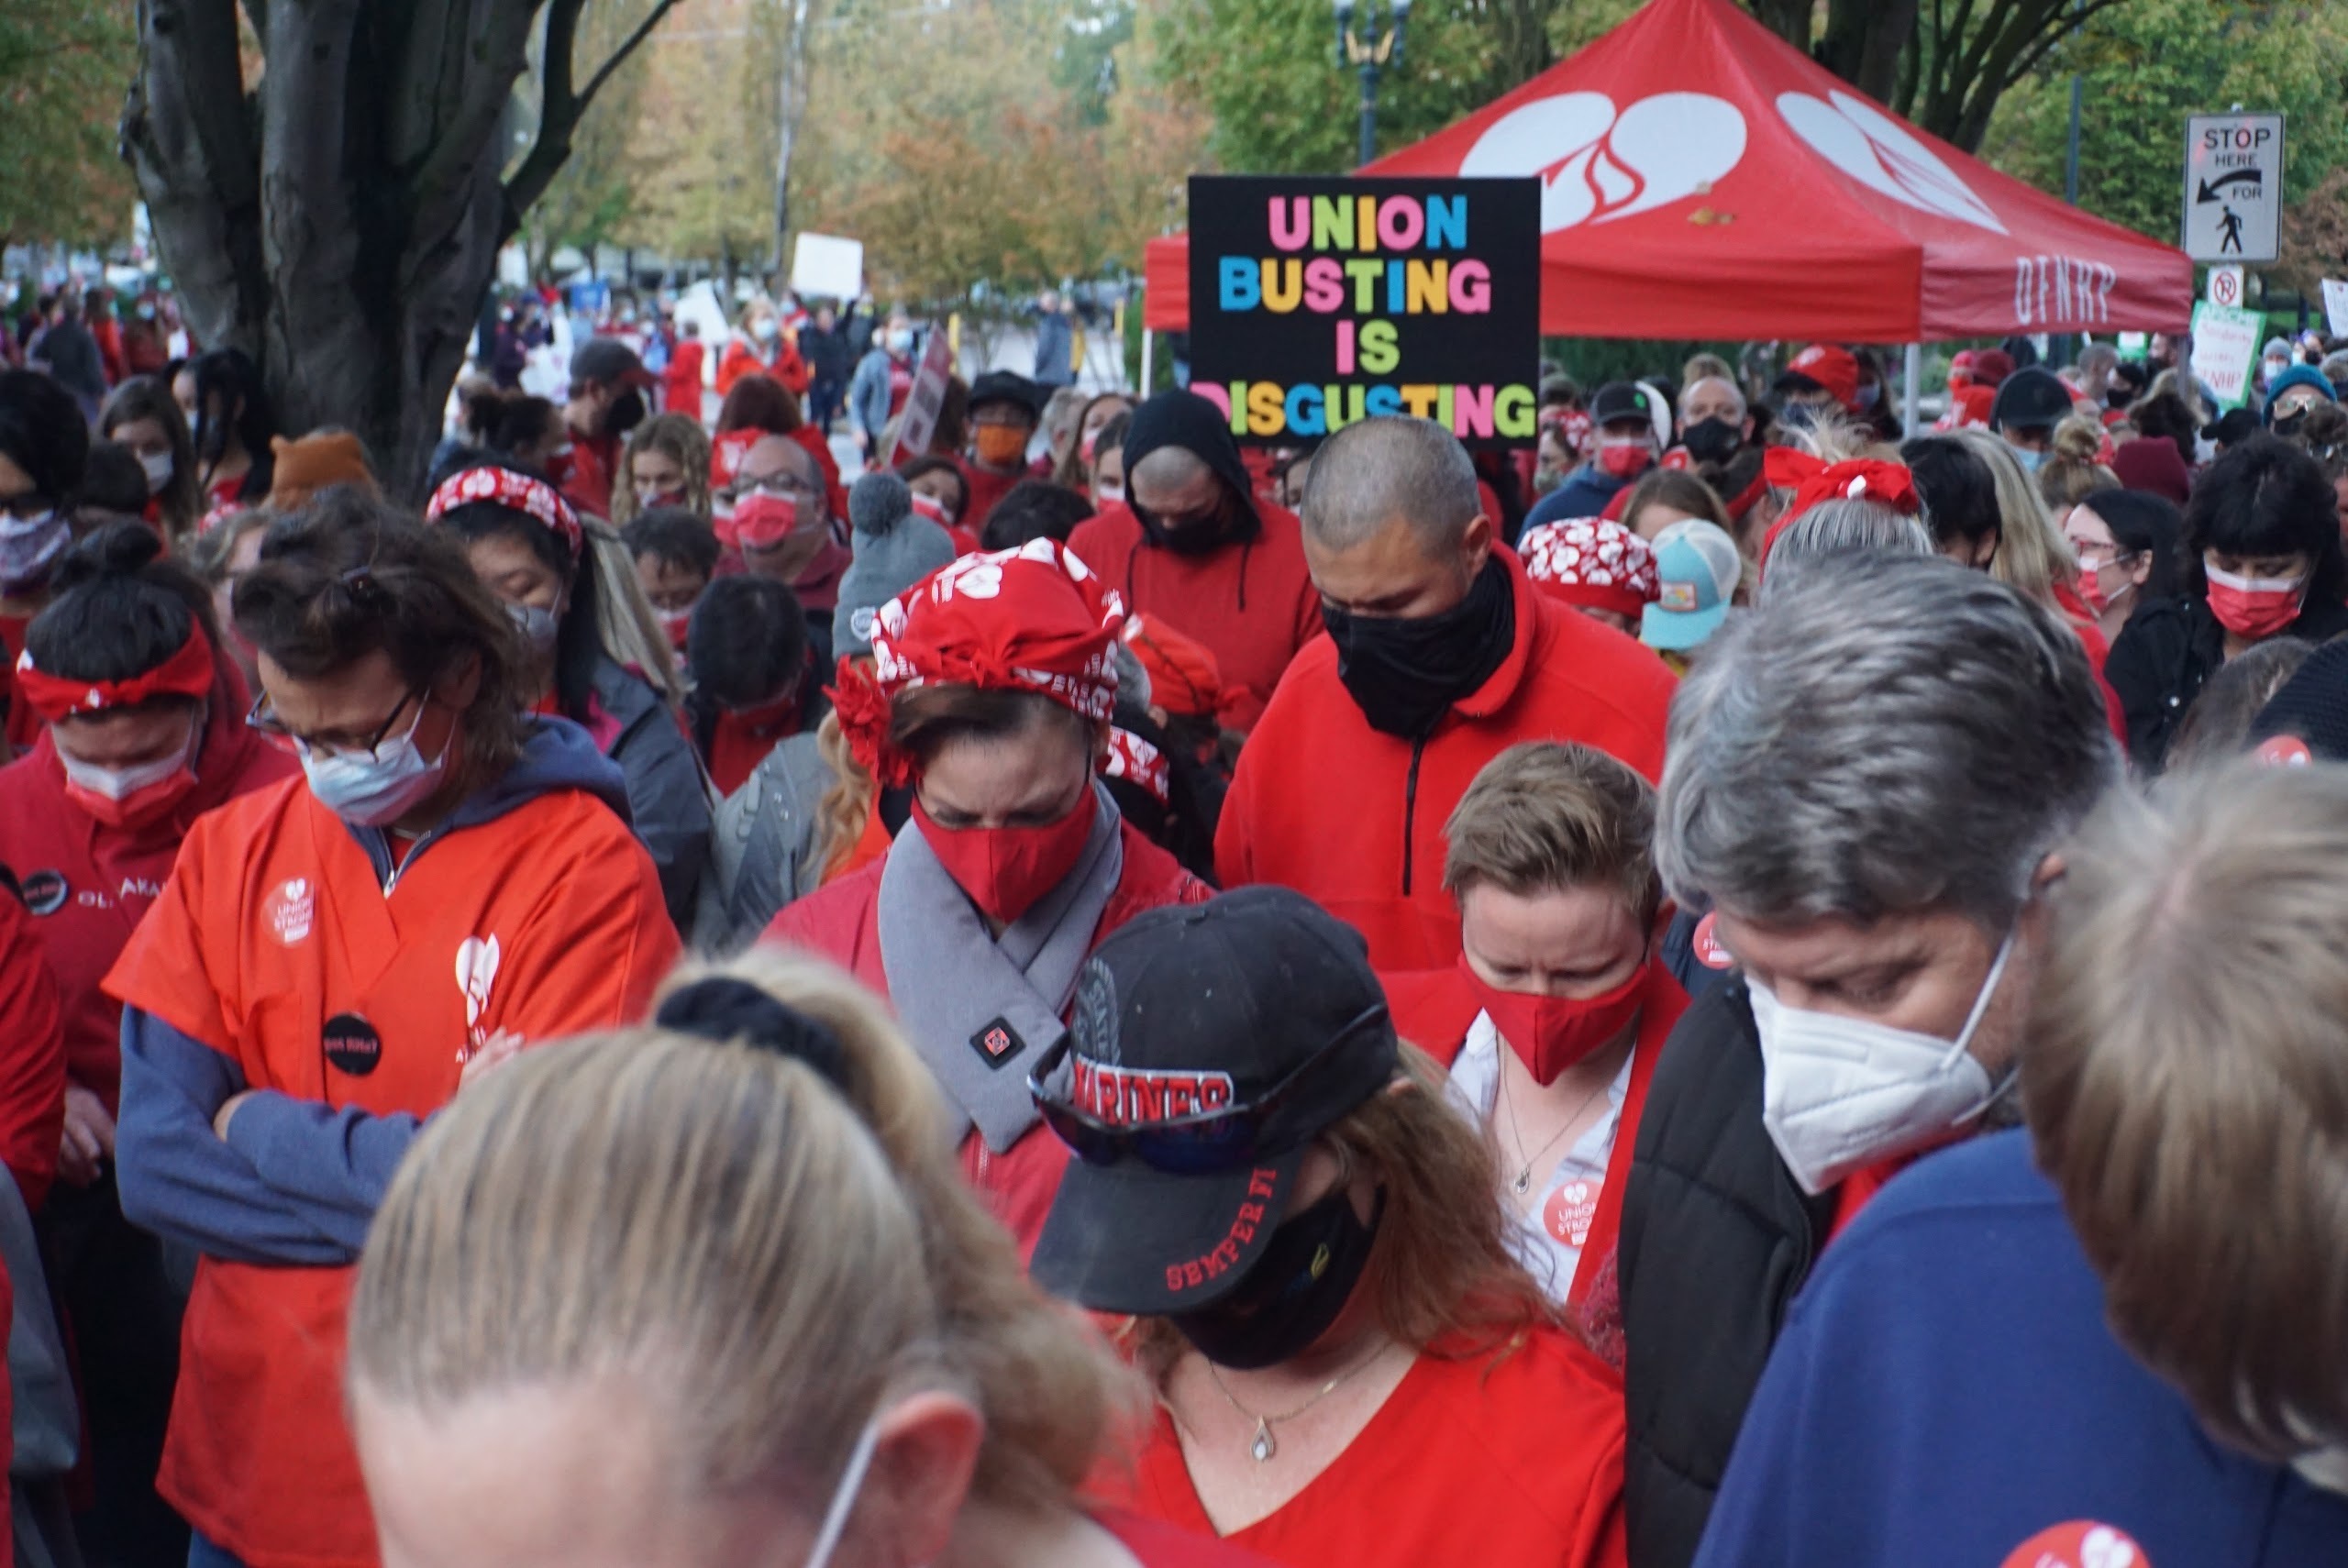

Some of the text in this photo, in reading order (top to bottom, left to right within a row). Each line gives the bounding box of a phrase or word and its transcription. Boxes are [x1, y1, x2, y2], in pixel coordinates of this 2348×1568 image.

[2204, 127, 2271, 149] STOP
[2215, 152, 2258, 169] HERE
[2232, 185, 2263, 200] FOR
[1268, 194, 1468, 252] UNION
[1219, 256, 1492, 315] BUSTING
[1335, 319, 1401, 375] IS
[1557, 1217, 1593, 1236] STRO
[1165, 1201, 1266, 1292] SEMPER
